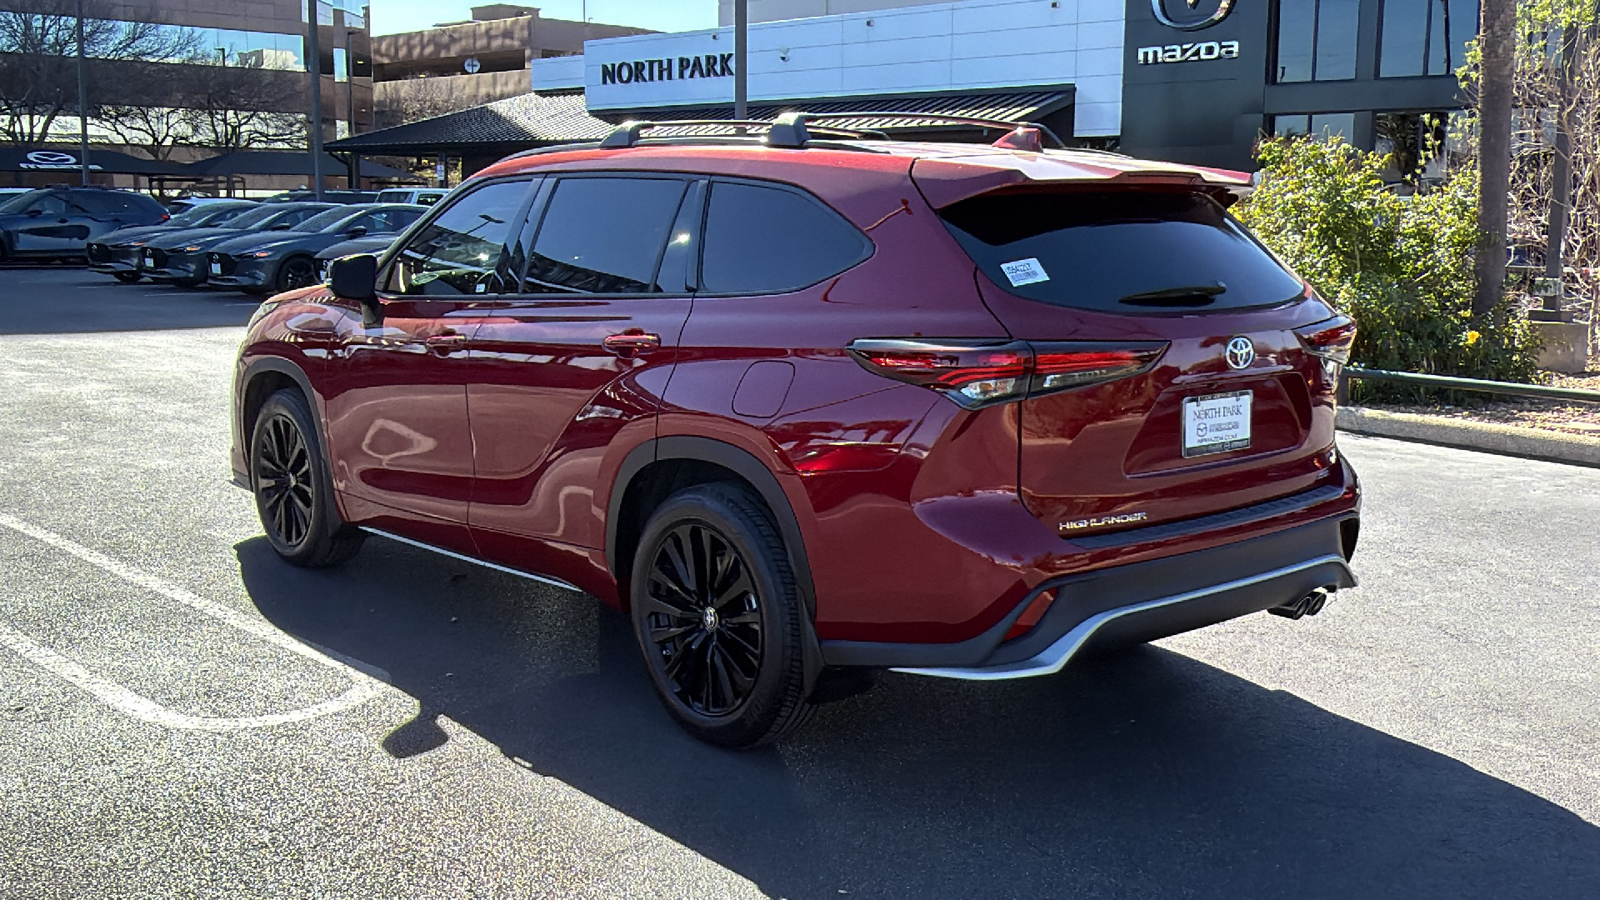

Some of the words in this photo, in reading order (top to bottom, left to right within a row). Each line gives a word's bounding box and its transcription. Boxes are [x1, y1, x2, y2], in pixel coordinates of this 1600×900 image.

[1137, 40, 1239, 64] mazda
[601, 58, 673, 85] NORTH
[678, 53, 734, 79] PARK
[1193, 408, 1220, 420] NORTH
[1223, 405, 1242, 417] PARK
[1059, 512, 1147, 530] HIGHLANDER
